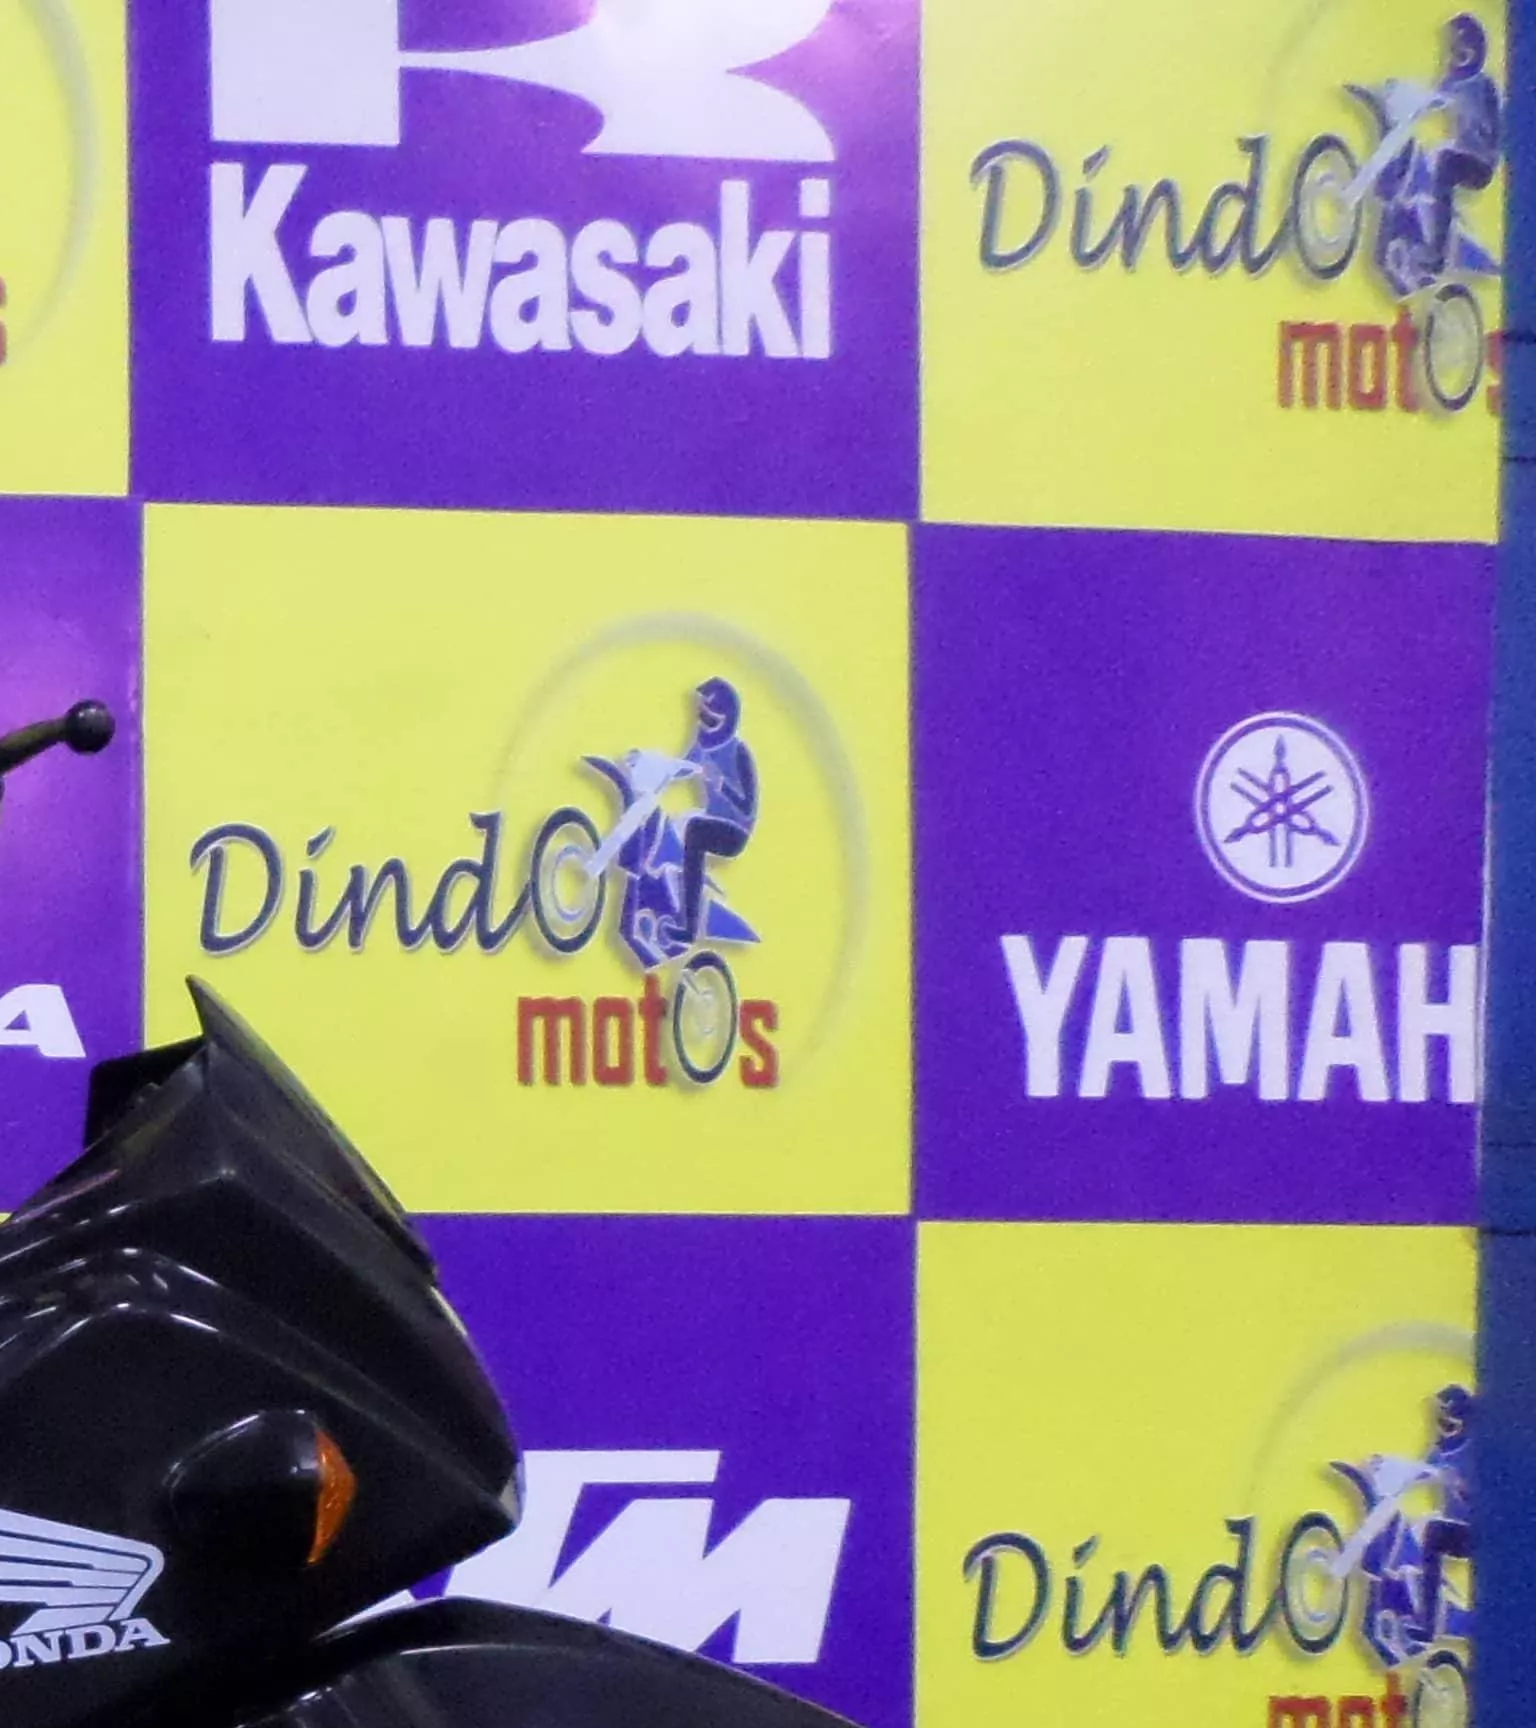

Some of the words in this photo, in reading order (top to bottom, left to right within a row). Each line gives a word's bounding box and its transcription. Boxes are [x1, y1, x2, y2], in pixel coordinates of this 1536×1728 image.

[210, 163, 832, 359] Kawasaki
[1000, 934, 1477, 1104] YAMAH
[330, 1449, 851, 1663] TM
